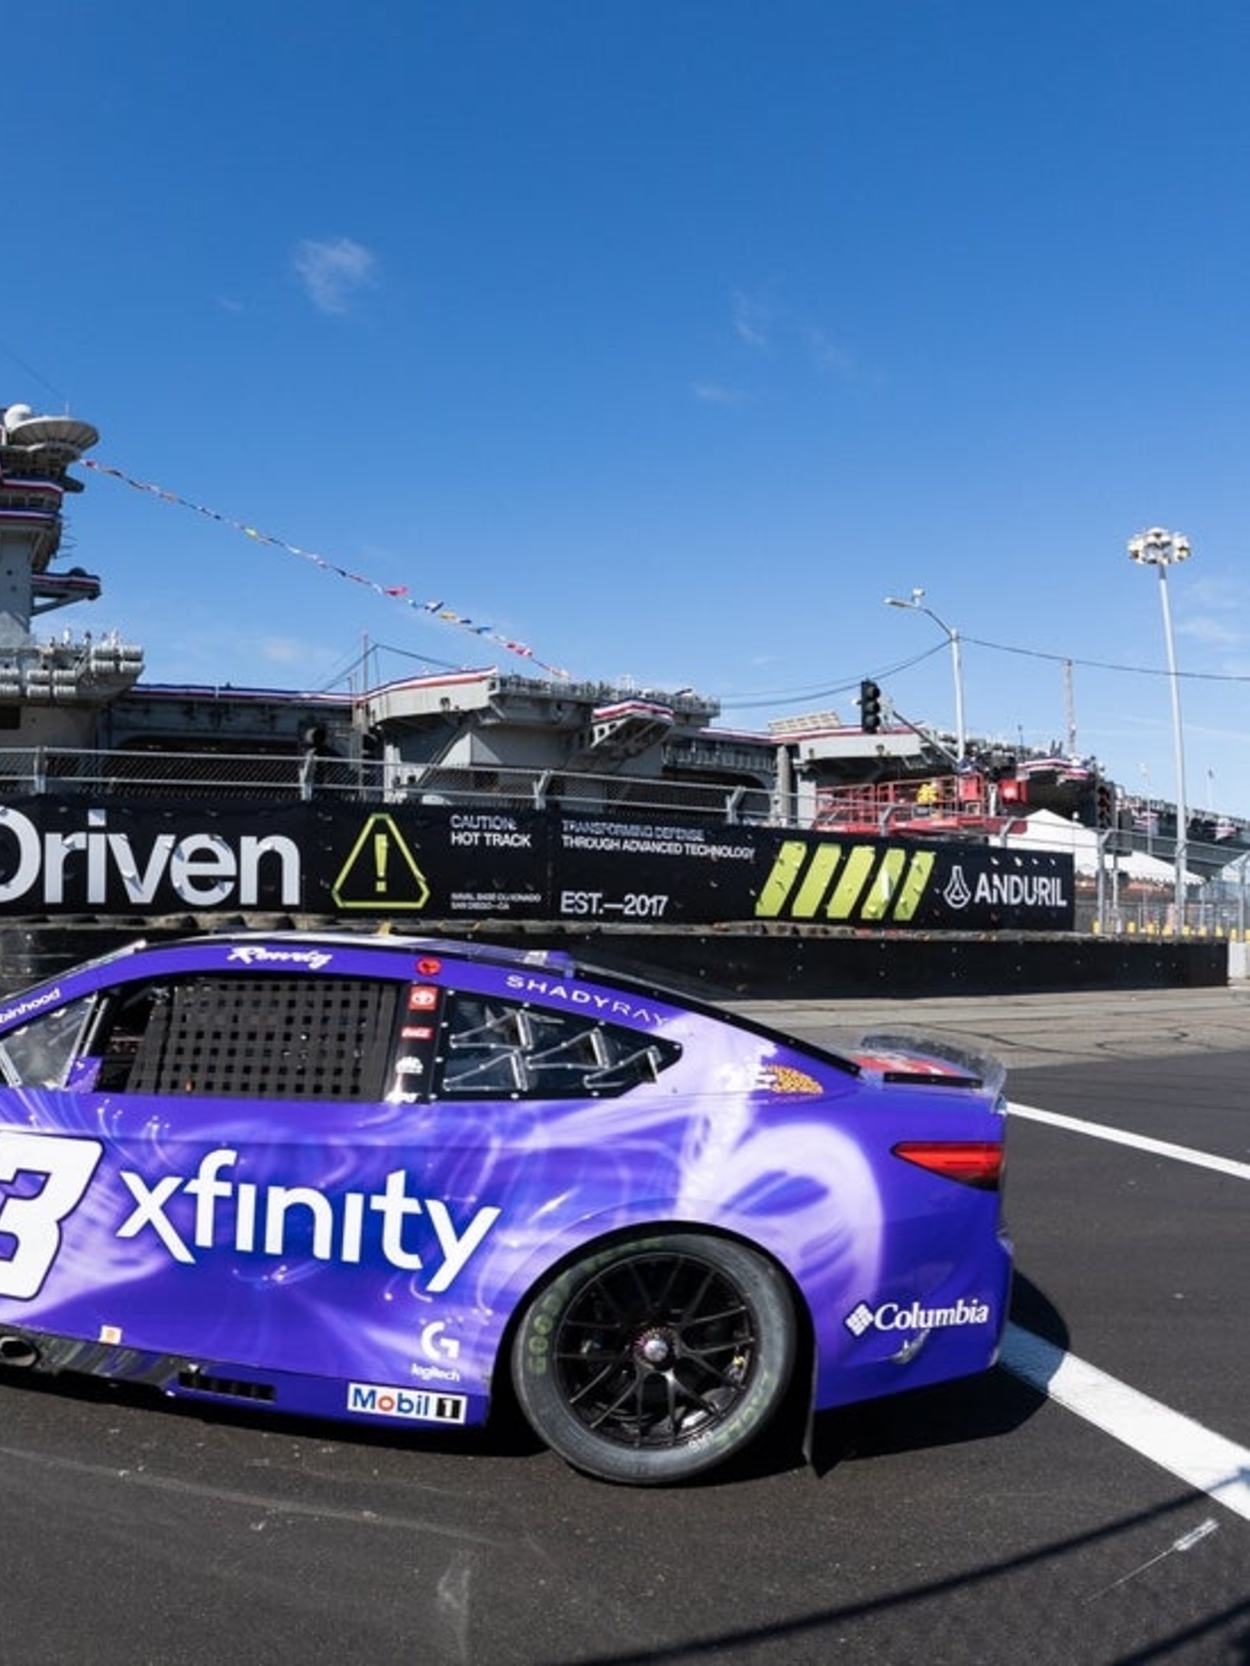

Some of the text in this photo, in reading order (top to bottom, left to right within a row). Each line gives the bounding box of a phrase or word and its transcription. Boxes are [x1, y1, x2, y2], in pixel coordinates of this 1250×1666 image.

[450, 831, 532, 848] HOT TRACK
[561, 835, 756, 859] THROUGH ADVANCED TECHNOLOGY
[974, 872, 1068, 907] ANDURIL
[115, 1149, 502, 1293] xfinity
[873, 1299, 990, 1331] Columbia
[352, 1387, 430, 1417] Mobil
